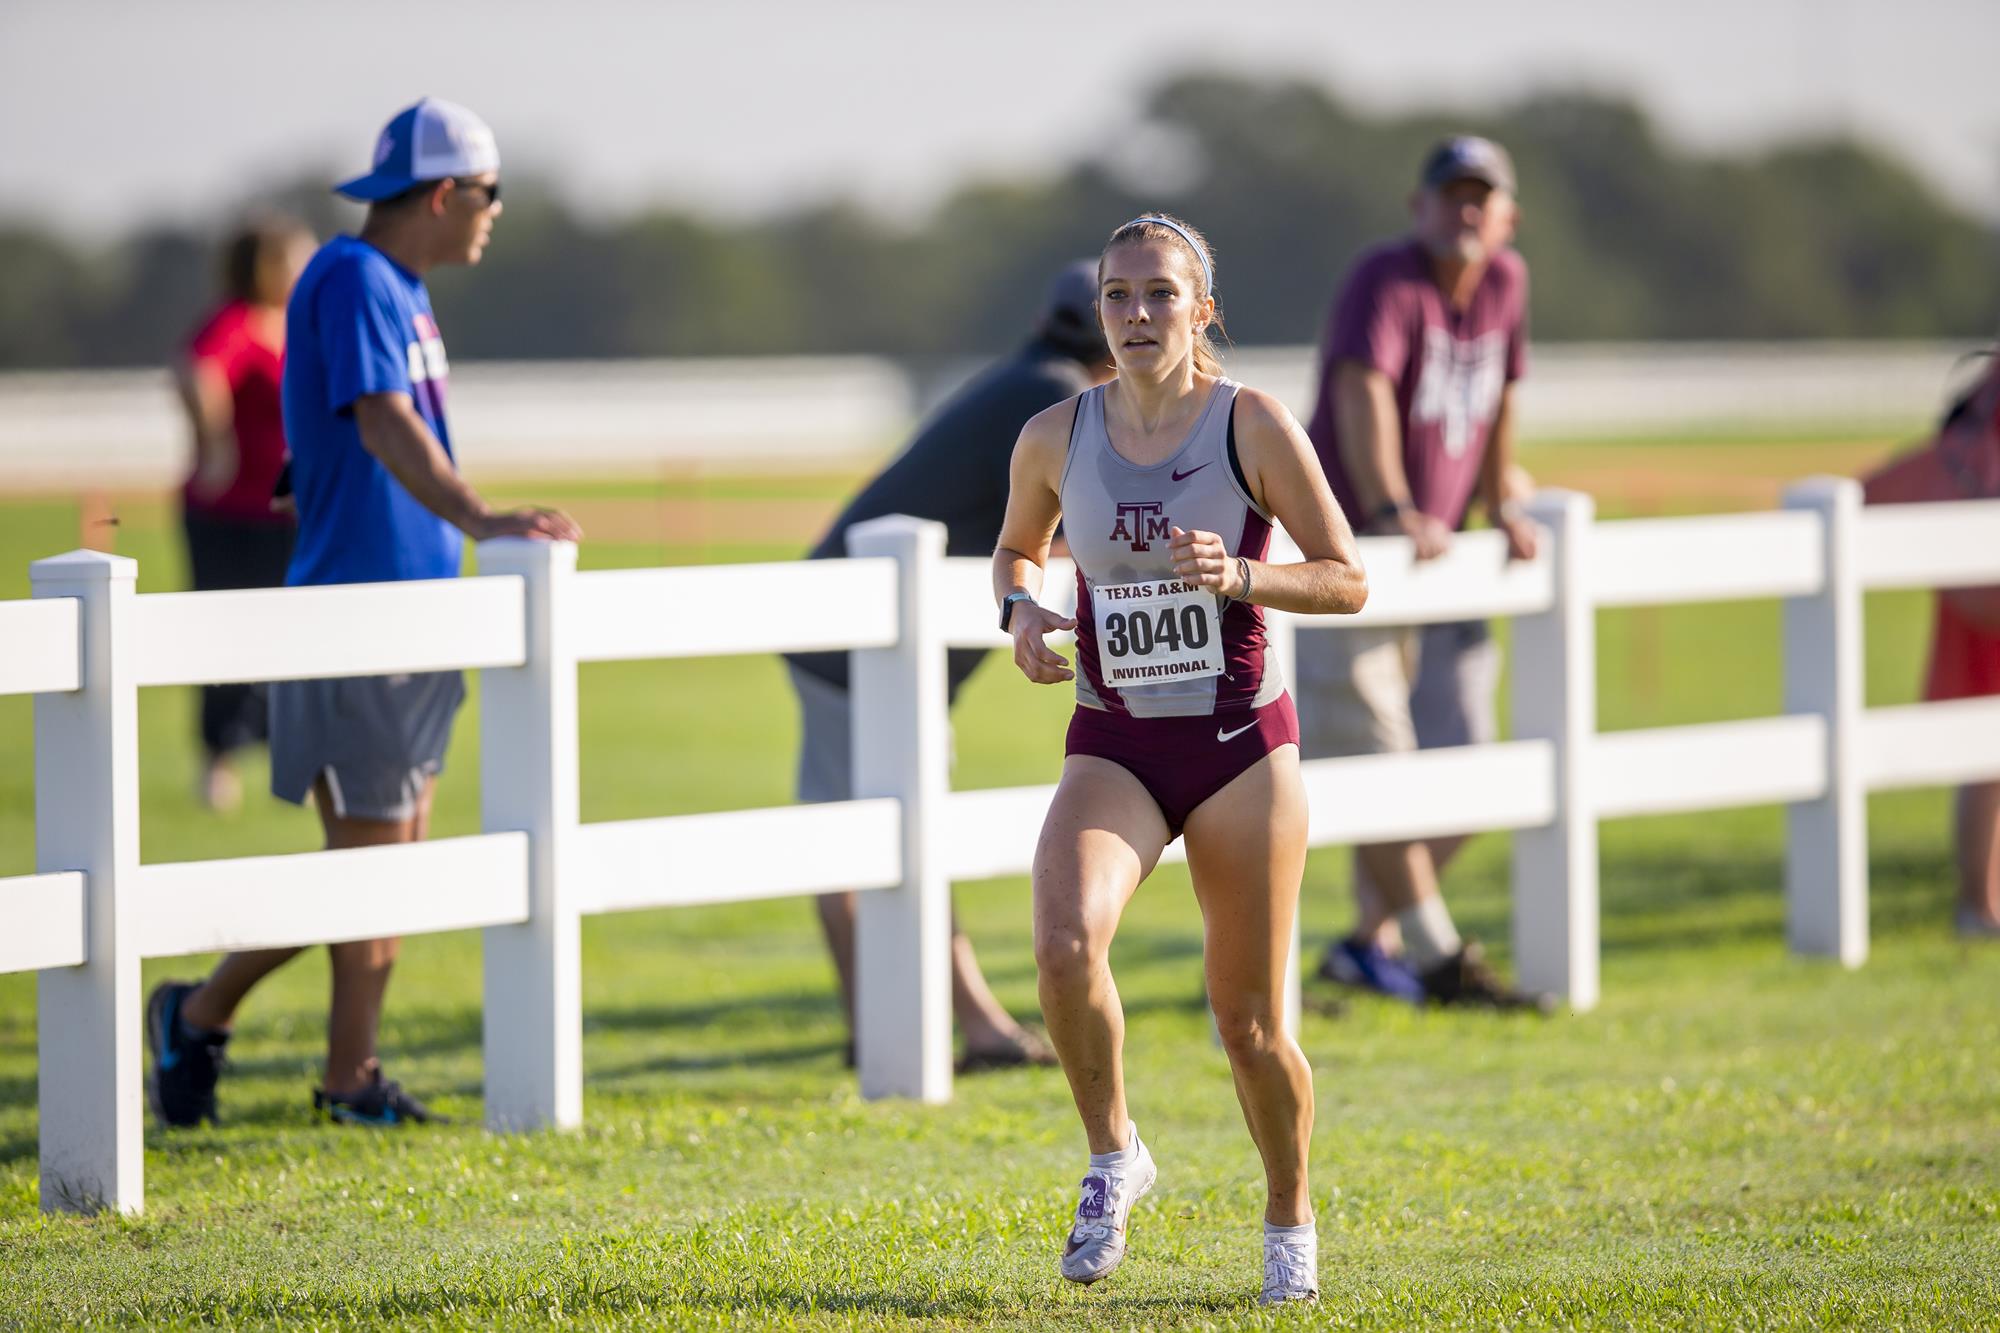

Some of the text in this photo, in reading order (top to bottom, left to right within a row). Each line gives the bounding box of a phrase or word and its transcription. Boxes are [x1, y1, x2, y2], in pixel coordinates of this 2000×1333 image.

[1105, 581, 1199, 600] TEXAS A&M
[1106, 604, 1209, 657] 3040
[1112, 660, 1210, 679] INVITATIONAL
